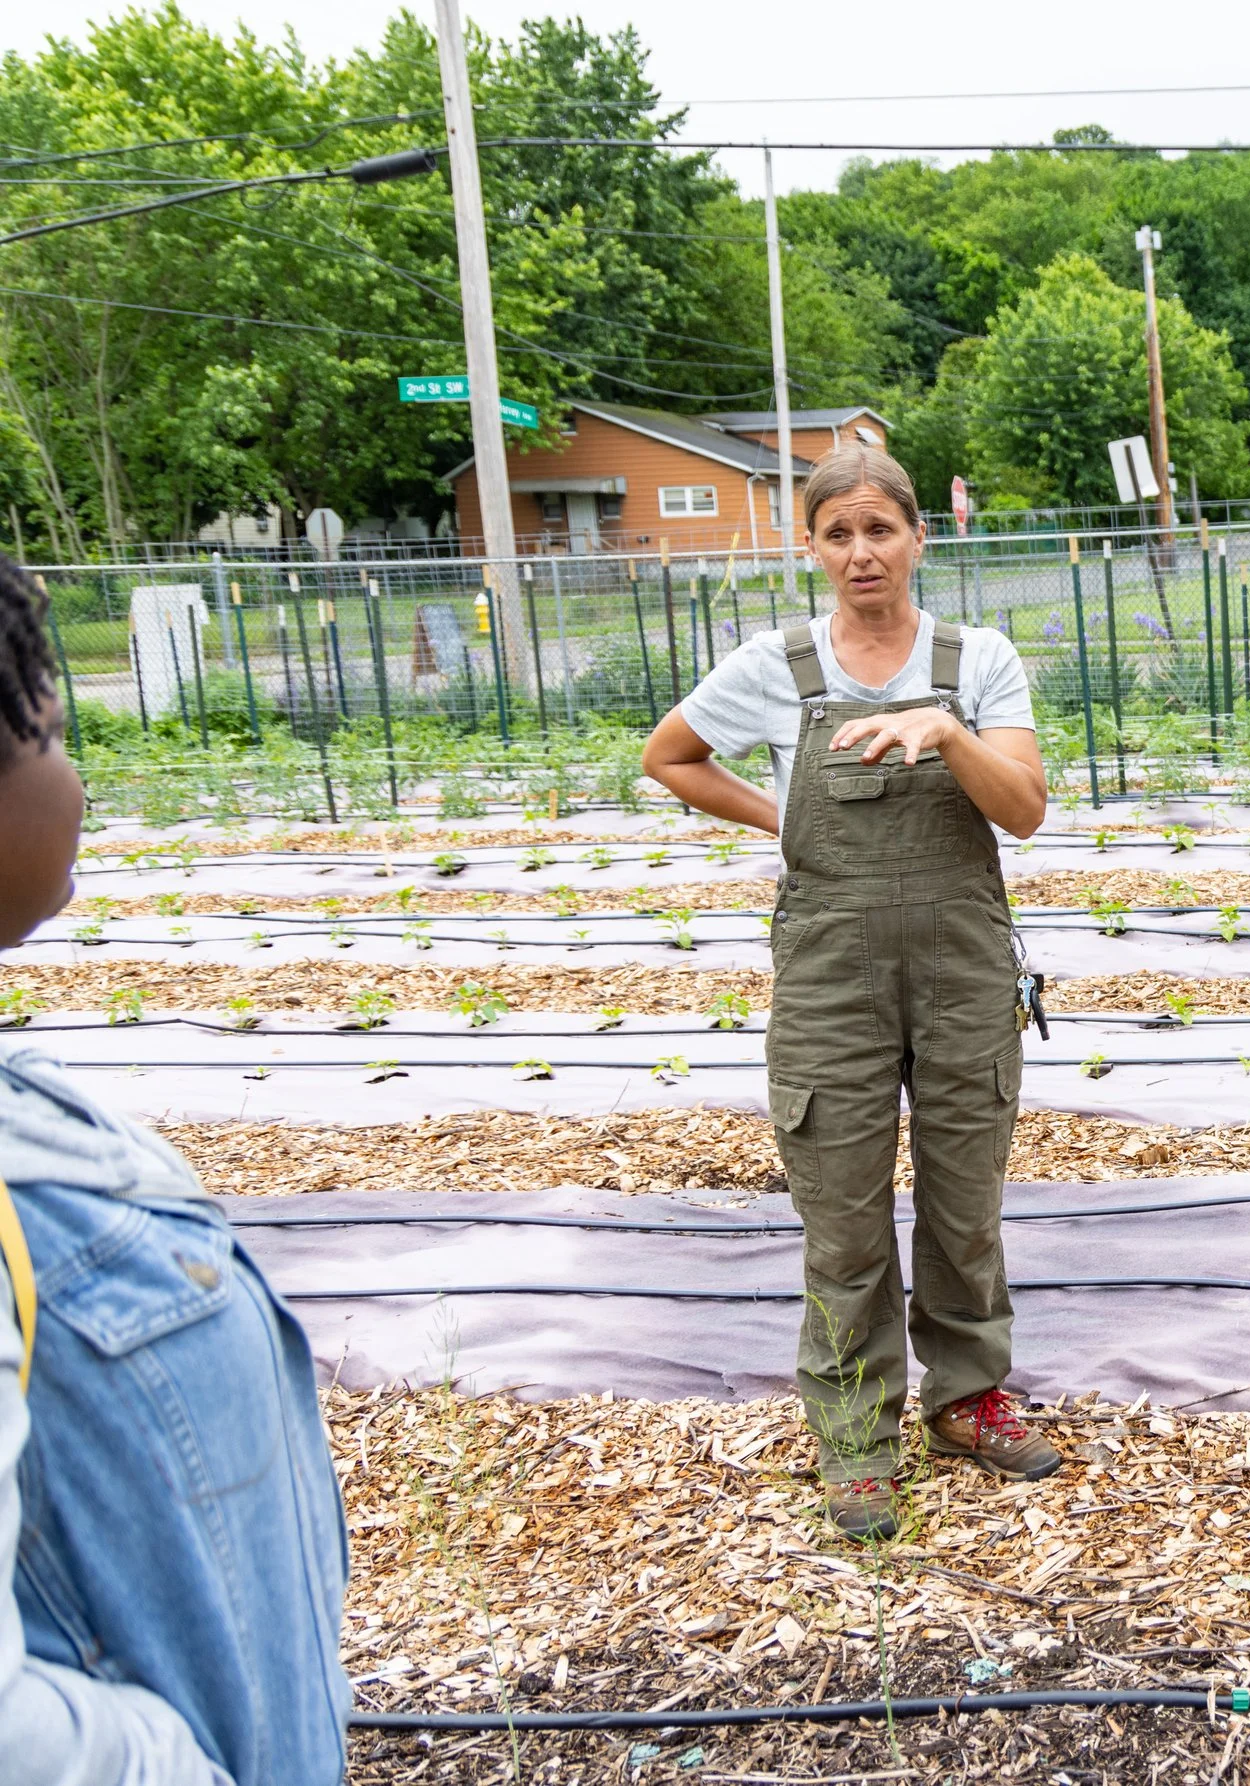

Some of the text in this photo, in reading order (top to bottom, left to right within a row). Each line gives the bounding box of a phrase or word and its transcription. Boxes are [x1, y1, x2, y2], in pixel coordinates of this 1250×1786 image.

[406, 381, 464, 396] 2nd St SW
